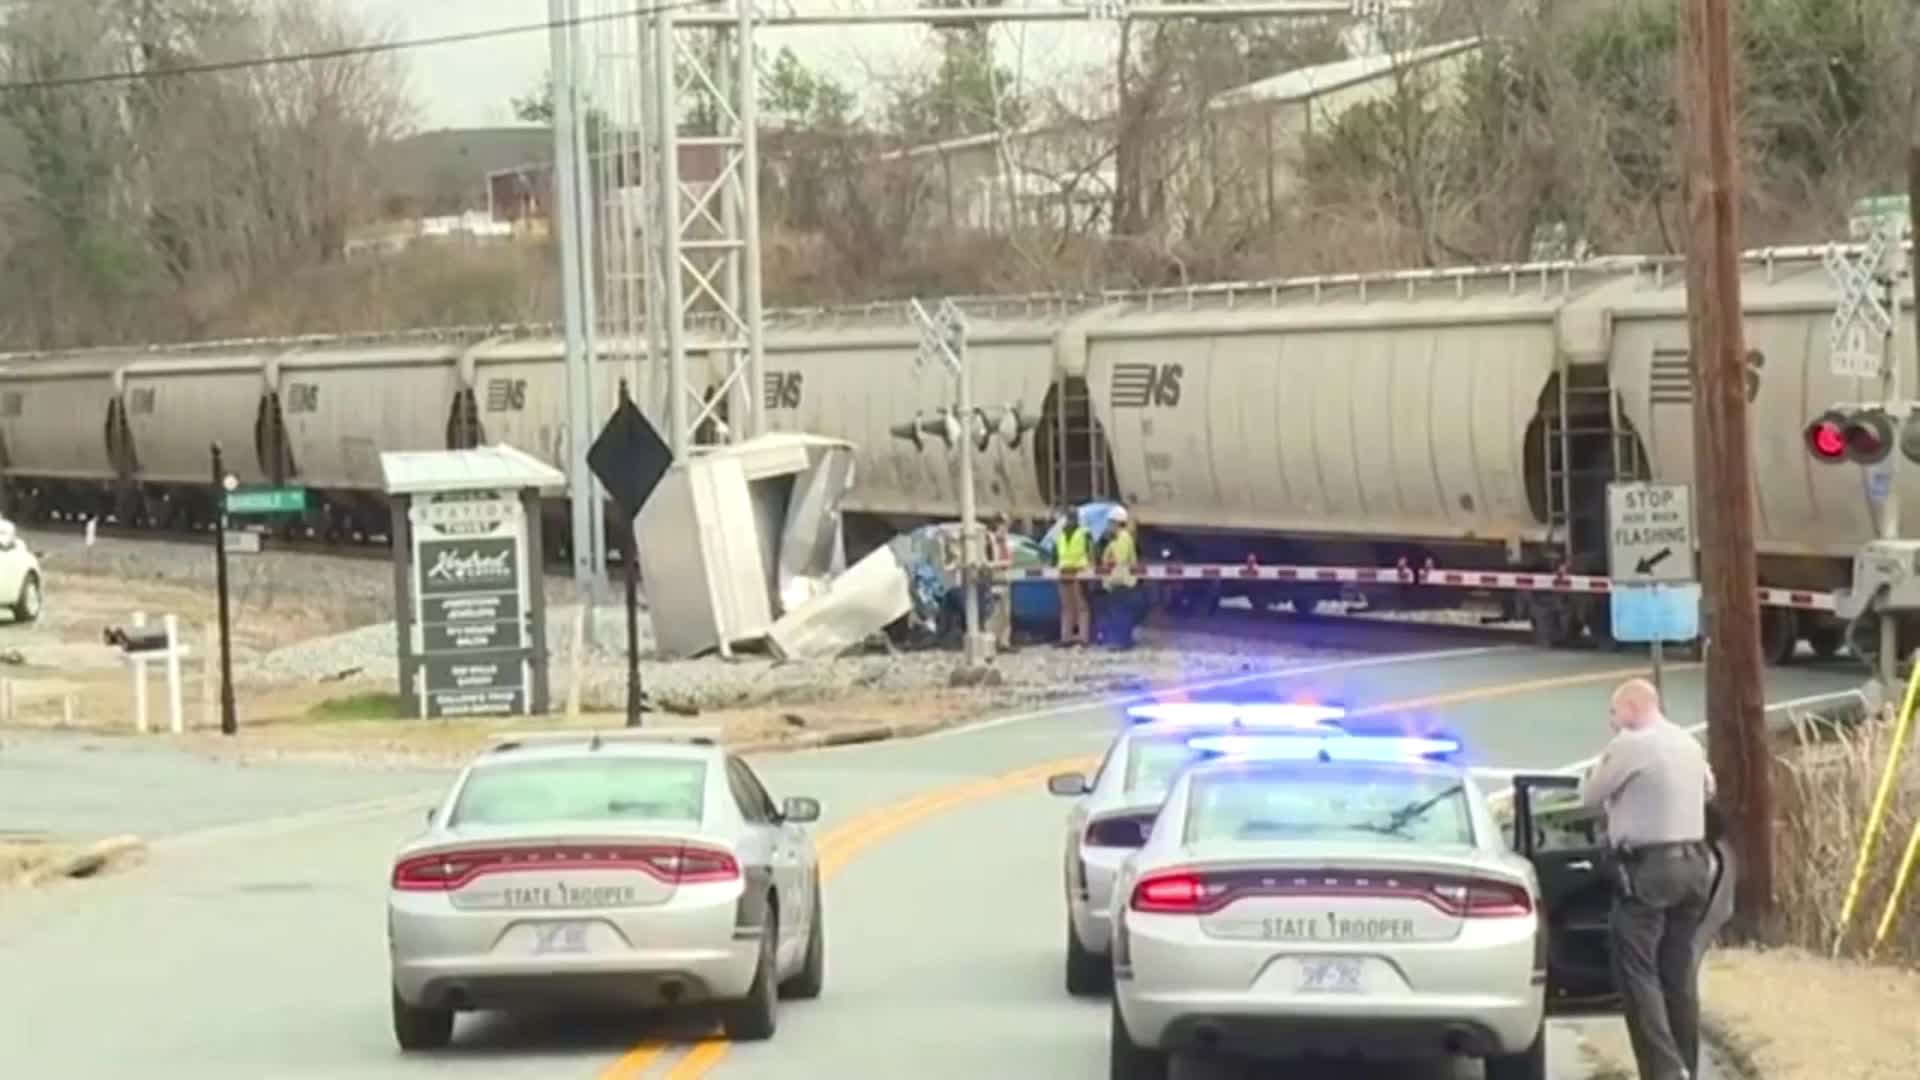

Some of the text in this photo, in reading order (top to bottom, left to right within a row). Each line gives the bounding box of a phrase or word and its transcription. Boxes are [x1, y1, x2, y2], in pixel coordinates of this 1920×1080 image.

[1141, 363, 1184, 407] NS
[1625, 489, 1674, 508] STOP
[1615, 527, 1686, 546] FLASHING
[504, 880, 634, 905] STATE TROOPER
[1262, 912, 1414, 937] STATE TROOPER
